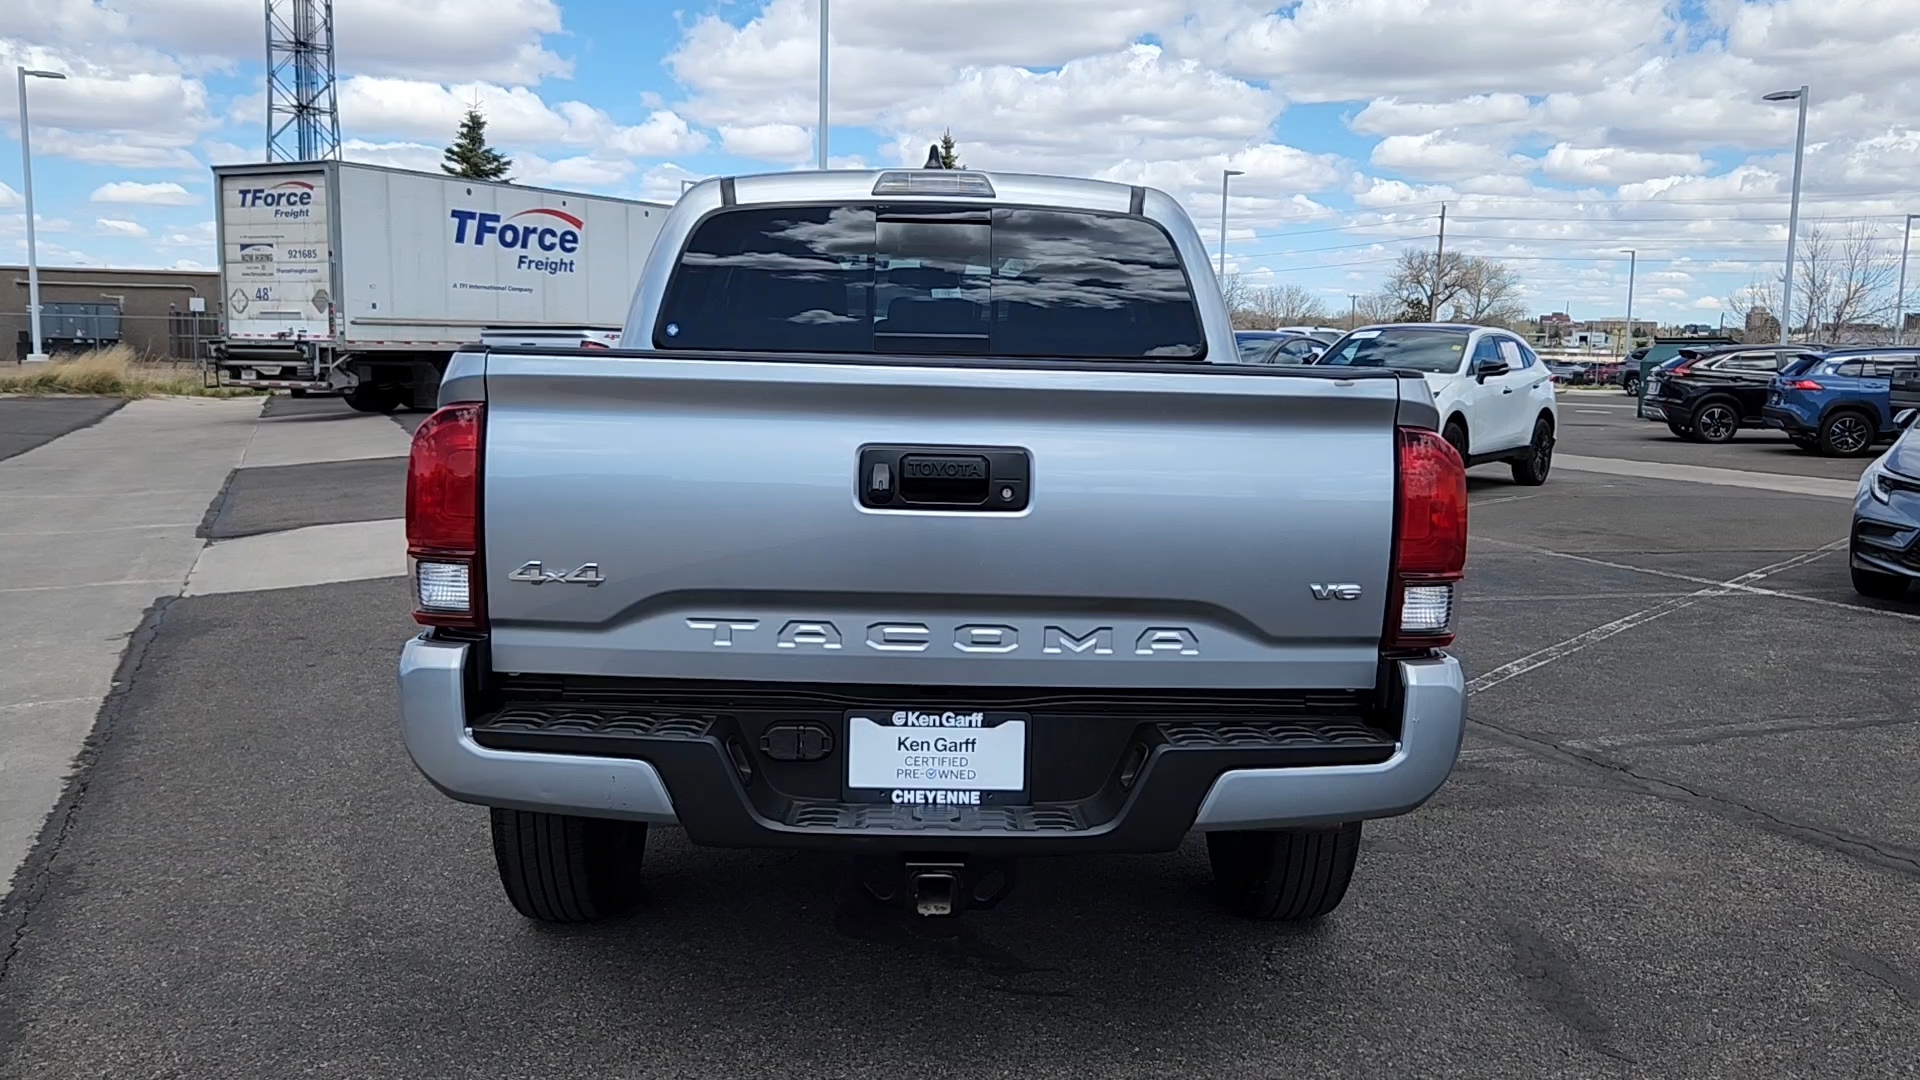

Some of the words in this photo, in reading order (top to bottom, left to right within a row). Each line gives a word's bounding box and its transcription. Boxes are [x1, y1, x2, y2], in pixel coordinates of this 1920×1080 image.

[238, 188, 312, 208] TForce
[274, 208, 309, 219] Freight
[450, 209, 579, 253] TForce
[287, 249, 317, 259] 921685
[517, 255, 575, 275] Freight
[468, 283, 507, 292] International
[507, 285, 534, 294] Company
[907, 461, 983, 477] TOYOTA
[1310, 583, 1362, 600] V6
[685, 617, 1199, 655] TACOMA
[897, 736, 931, 752] Ken
[934, 737, 977, 753] Garff
[904, 756, 969, 767] CERTIFIED
[891, 789, 981, 805] CHEYENNE
